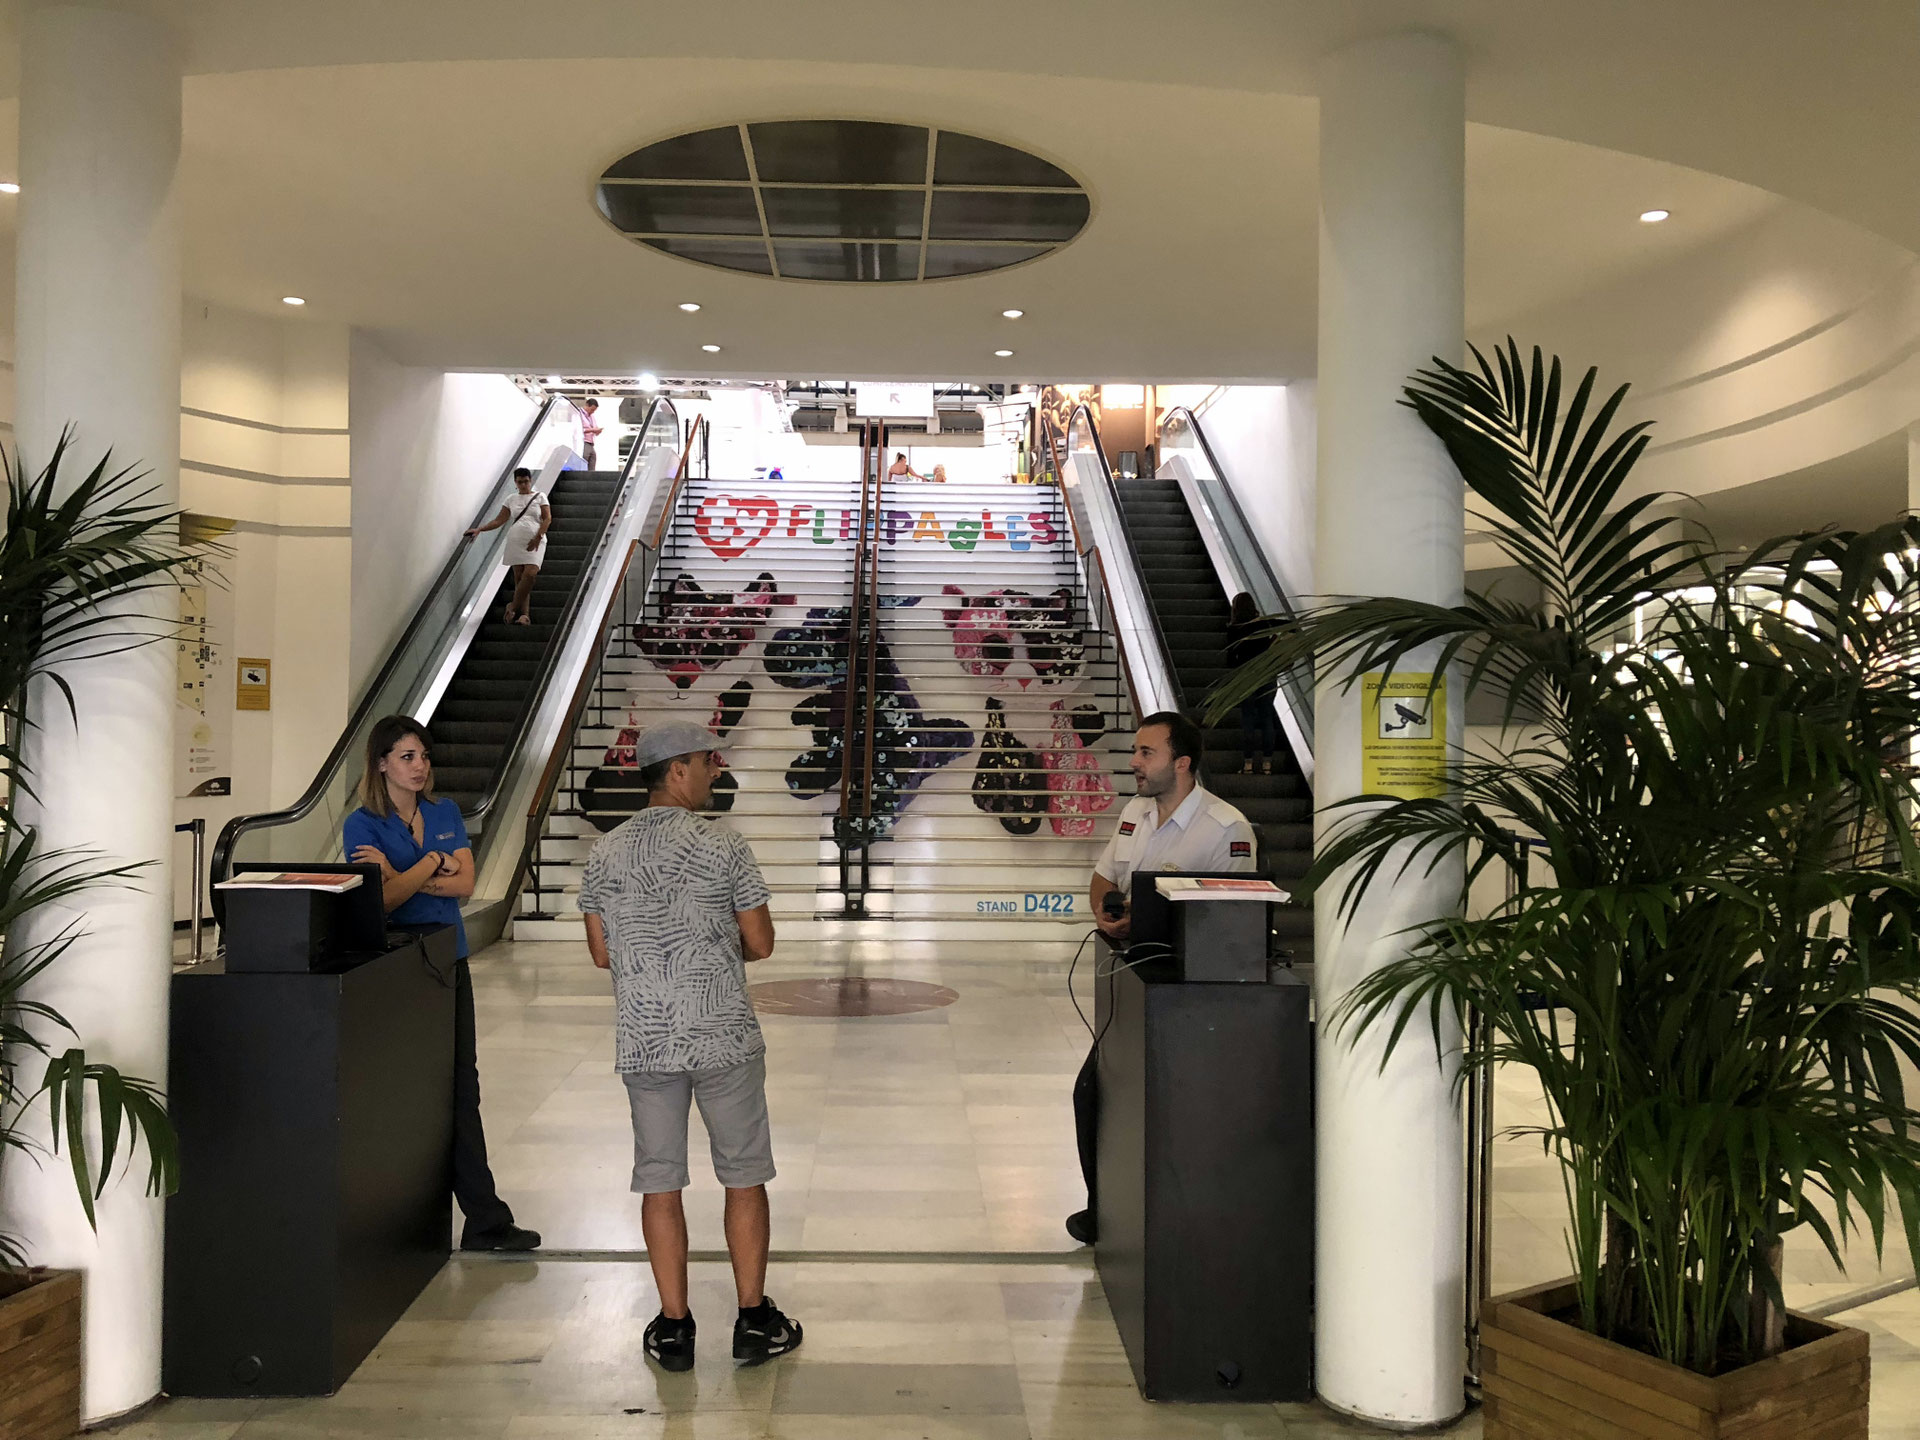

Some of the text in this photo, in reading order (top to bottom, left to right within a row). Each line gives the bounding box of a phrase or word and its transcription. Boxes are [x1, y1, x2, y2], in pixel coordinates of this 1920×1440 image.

[1389, 682, 1443, 690] VIDEOVIGILA
[977, 893, 1074, 913] STAND D422
